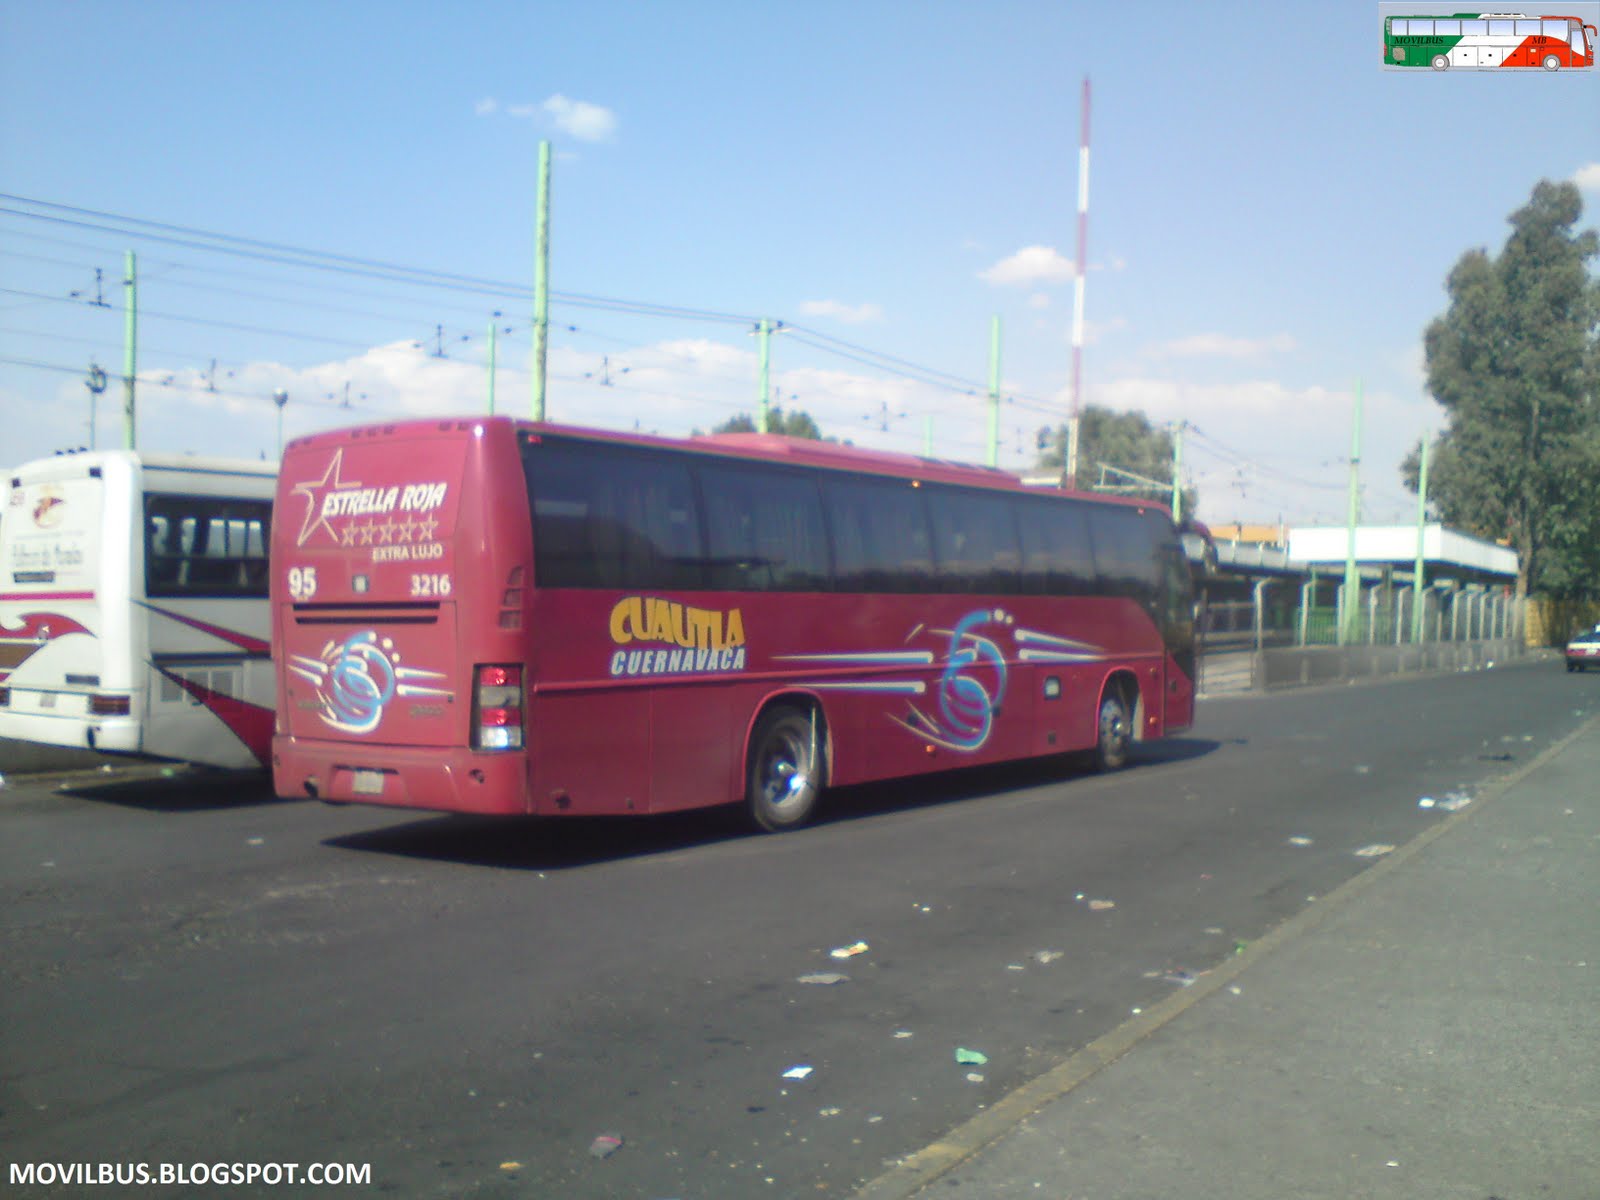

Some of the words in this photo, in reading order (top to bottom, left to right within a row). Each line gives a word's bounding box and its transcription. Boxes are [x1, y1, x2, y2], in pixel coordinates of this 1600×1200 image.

[321, 486, 399, 518] ESTRELLA
[400, 482, 448, 512] ROJA
[372, 546, 409, 563] EXTRA
[412, 542, 443, 560] LUJO
[288, 567, 317, 597] 95
[410, 573, 451, 597] 3216
[609, 596, 745, 651] CUAUTLA
[610, 647, 746, 675] CUERNAVACA
